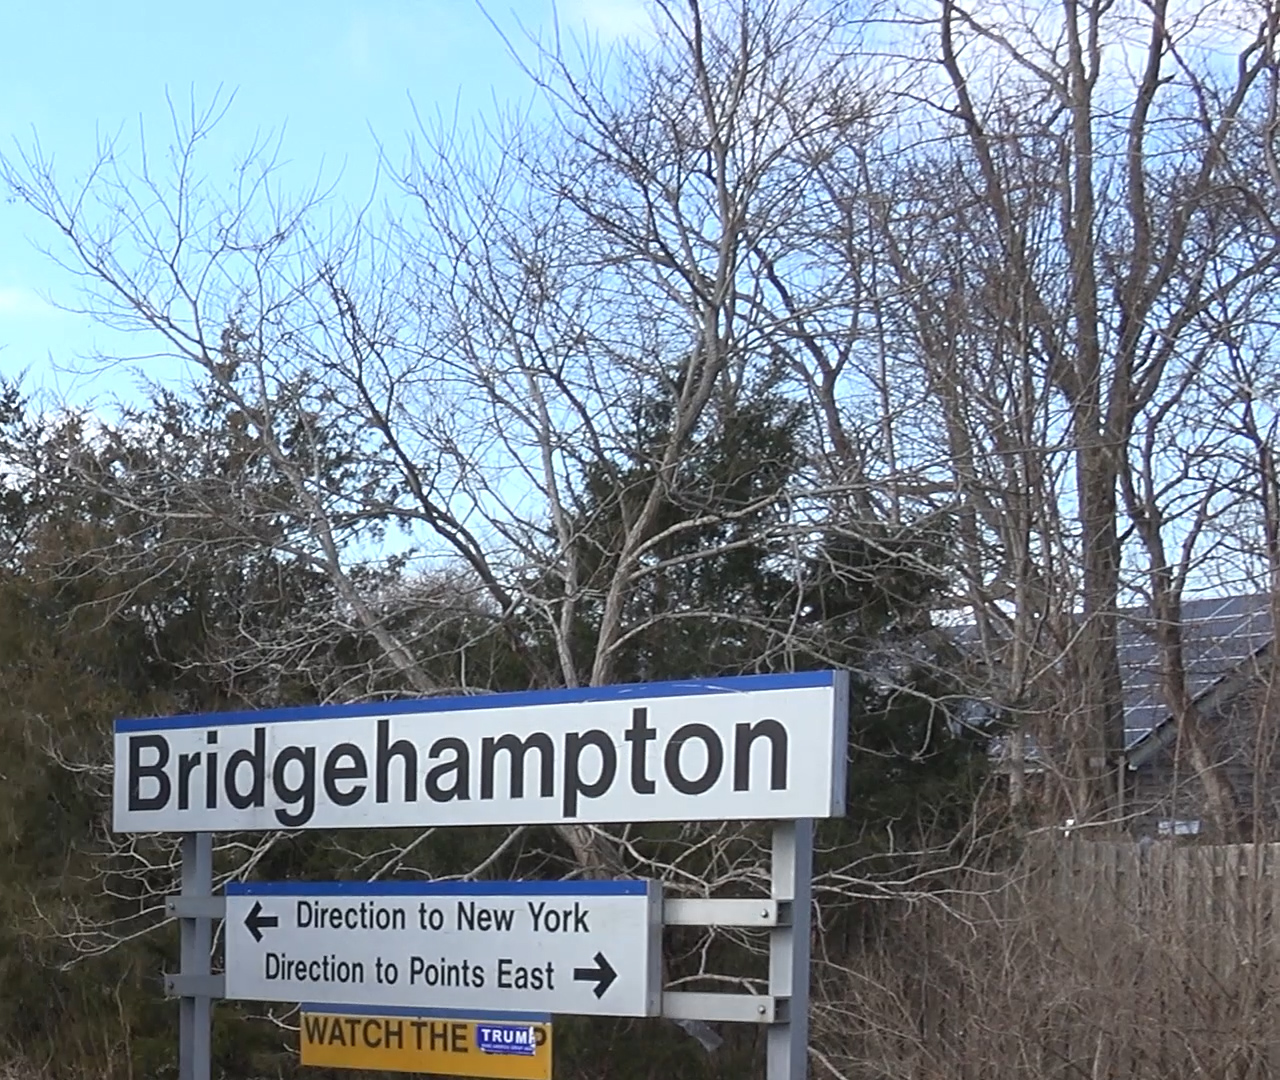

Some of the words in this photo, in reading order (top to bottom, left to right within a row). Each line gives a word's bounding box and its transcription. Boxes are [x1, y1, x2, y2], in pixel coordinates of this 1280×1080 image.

[127, 706, 789, 827] Bridgehampton
[296, 900, 406, 930] Direction
[419, 904, 444, 931] to
[457, 902, 515, 932] New
[528, 902, 590, 933] York
[265, 952, 364, 983] Direction
[375, 957, 399, 985] to
[409, 957, 485, 988] Points
[497, 959, 555, 990] East
[304, 1016, 404, 1050] WATCH
[411, 1021, 469, 1053] THE
